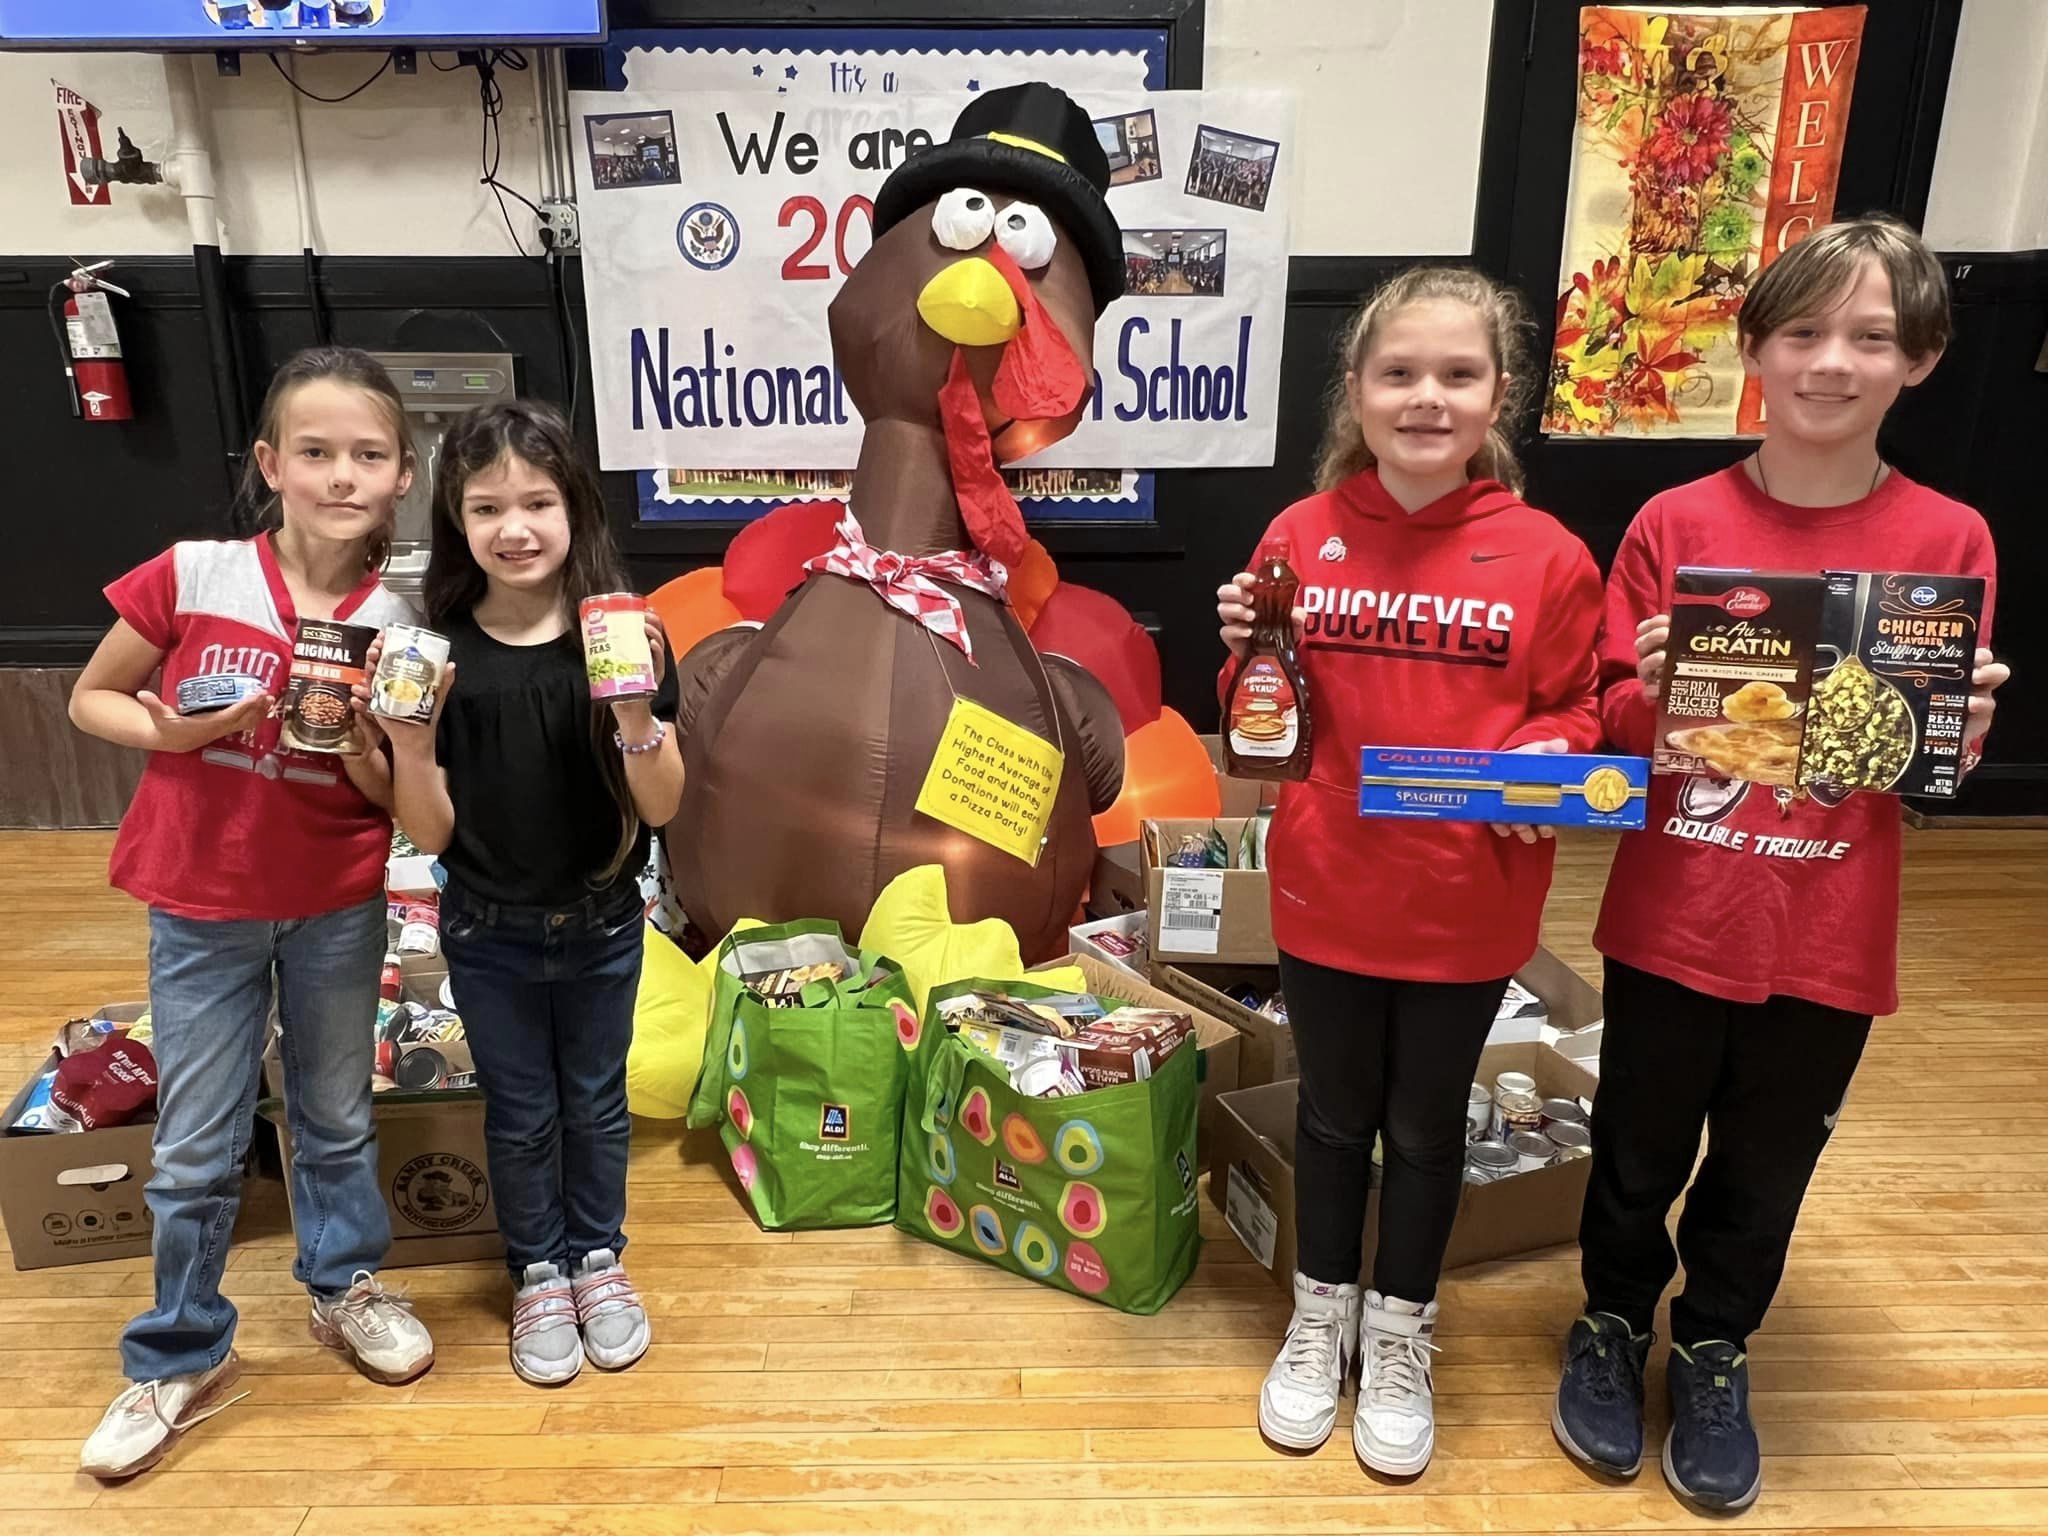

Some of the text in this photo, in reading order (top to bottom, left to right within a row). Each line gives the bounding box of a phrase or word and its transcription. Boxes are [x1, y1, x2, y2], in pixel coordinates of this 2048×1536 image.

[830, 62, 867, 93] It's
[716, 111, 934, 175] We are
[777, 194, 875, 280] 20
[1955, 265, 1973, 279] 17
[631, 327, 849, 430] National
[1114, 316, 1253, 422] School
[1303, 586, 1514, 655] BUCKEYES
[1726, 621, 1756, 637] Au
[1878, 618, 1964, 638] CHICKEN
[589, 643, 611, 656] PEAS
[1689, 635, 1792, 657] GRATIN
[1870, 640, 1965, 661] Stuffing Mix
[1893, 635, 1944, 647] FLAVORED
[199, 643, 281, 689] OHIO
[1249, 684, 1279, 694] SYRUP
[1689, 681, 1720, 699] REAL
[1667, 706, 1718, 718] POTATOES
[1668, 695, 1720, 709] SLICED
[1928, 714, 1963, 725] REAL
[1925, 729, 1960, 738] BROTH
[963, 724, 1054, 781] The Class with the
[1377, 753, 1492, 766] COLUMBIA
[1933, 746, 1958, 756] MIN
[952, 738, 995, 768] Highest
[998, 762, 1041, 790] Average
[956, 757, 1041, 811] Food and Money
[942, 768, 1041, 825] Donations will earn
[1395, 790, 1468, 804] SPAGHETTI
[950, 793, 1028, 837] a Pizza Party!
[1663, 816, 1749, 851] DOUBLE
[1753, 834, 1850, 860] TROUBLE
[824, 1125, 844, 1133] ALDI
